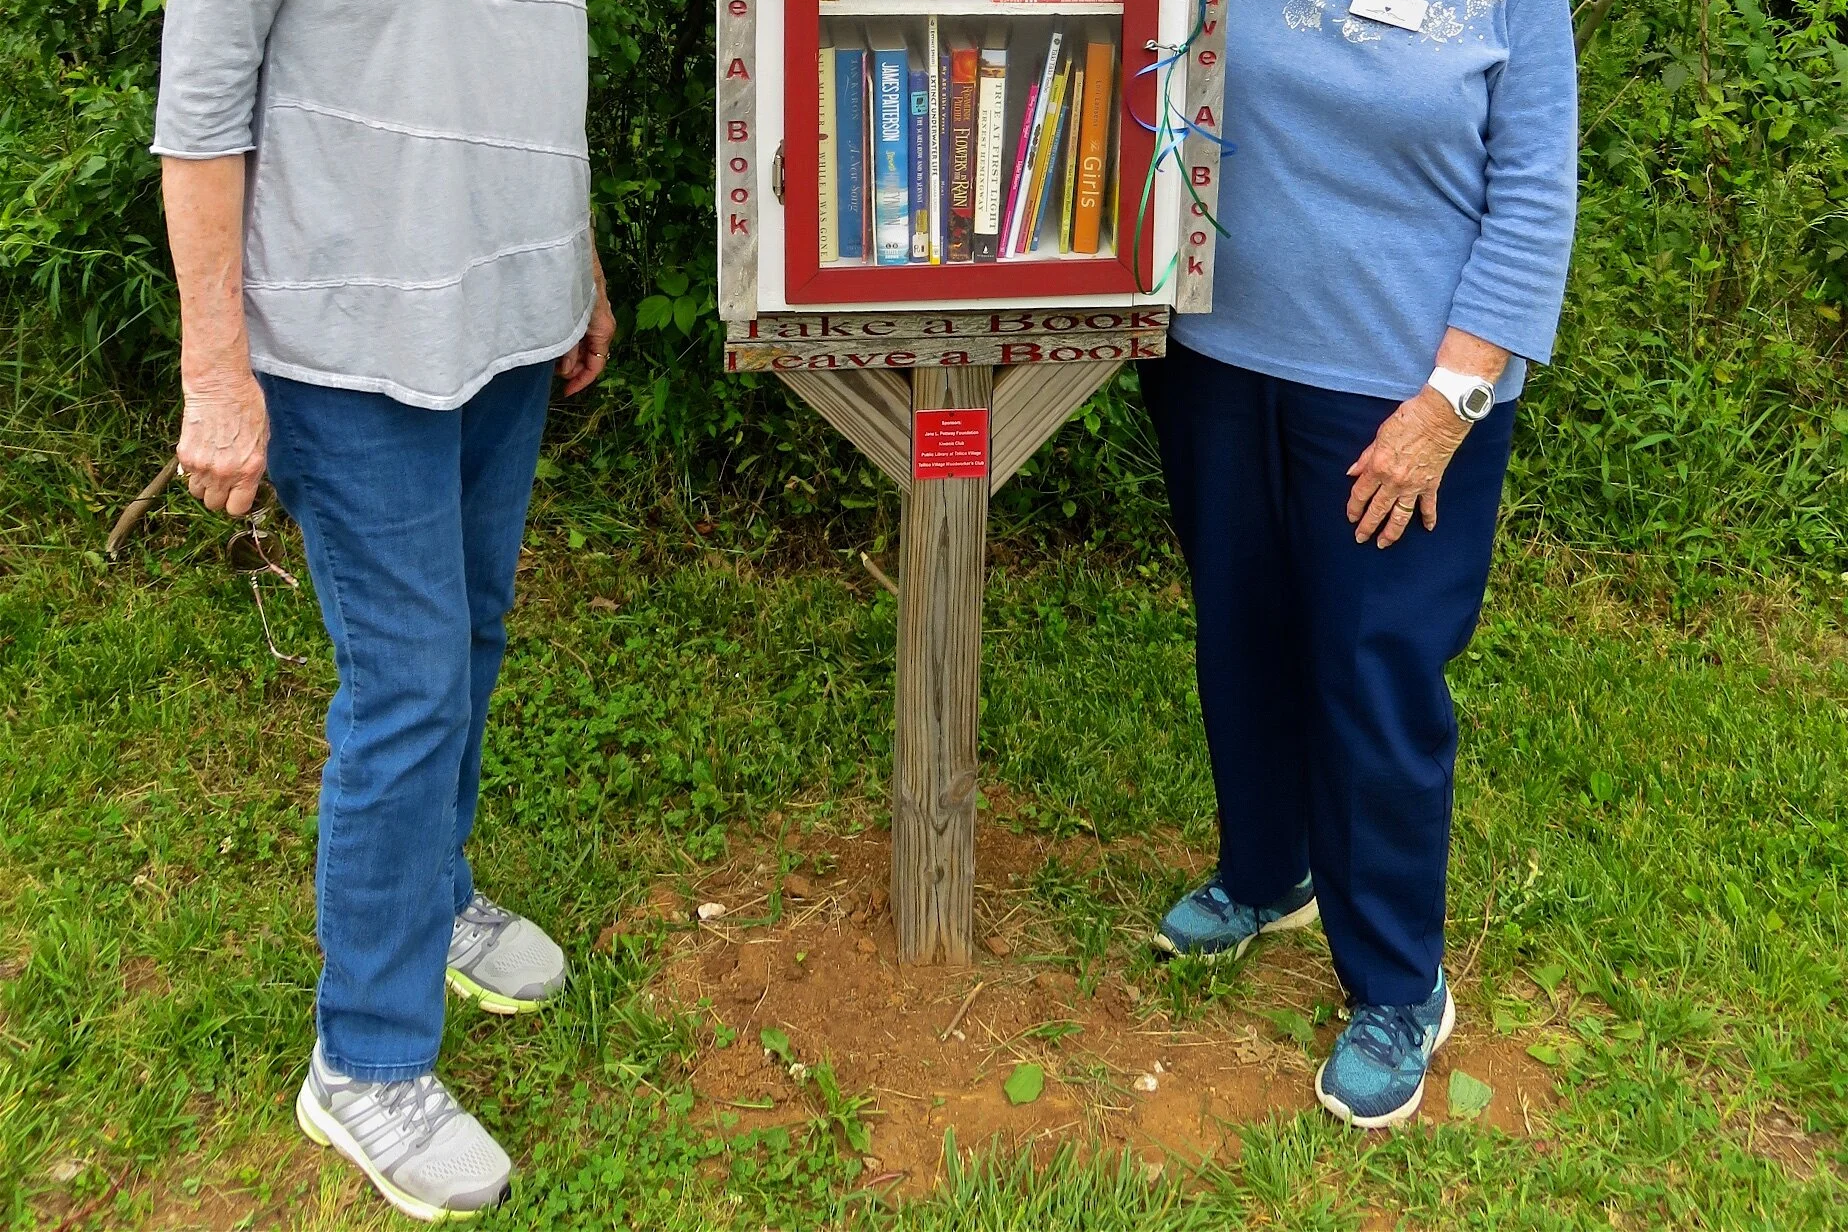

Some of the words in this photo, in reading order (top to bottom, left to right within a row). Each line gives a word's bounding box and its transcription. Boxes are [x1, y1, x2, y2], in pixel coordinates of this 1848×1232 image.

[725, 57, 750, 82] A
[882, 62, 900, 93] JAMES
[851, 82, 859, 120] KARON
[882, 94, 900, 142] PATTERSON
[994, 83, 1003, 119] TRUE
[1194, 104, 1217, 127] A
[993, 123, 1000, 141] AT
[954, 128, 970, 173] FLOWERS
[991, 145, 999, 185] FIRST
[727, 120, 749, 239] Book
[951, 180, 969, 207] RAIN
[978, 152, 986, 212] HEMINGWAY
[1081, 156, 1102, 208] Girls
[848, 184, 861, 213] Song
[990, 190, 998, 230] LIGHT
[1187, 165, 1212, 277] Book
[820, 227, 828, 257] GONE
[741, 317, 897, 339] Take
[923, 319, 961, 335] a
[983, 311, 1169, 333] Book
[938, 349, 975, 366] a
[1000, 337, 1160, 365] Book
